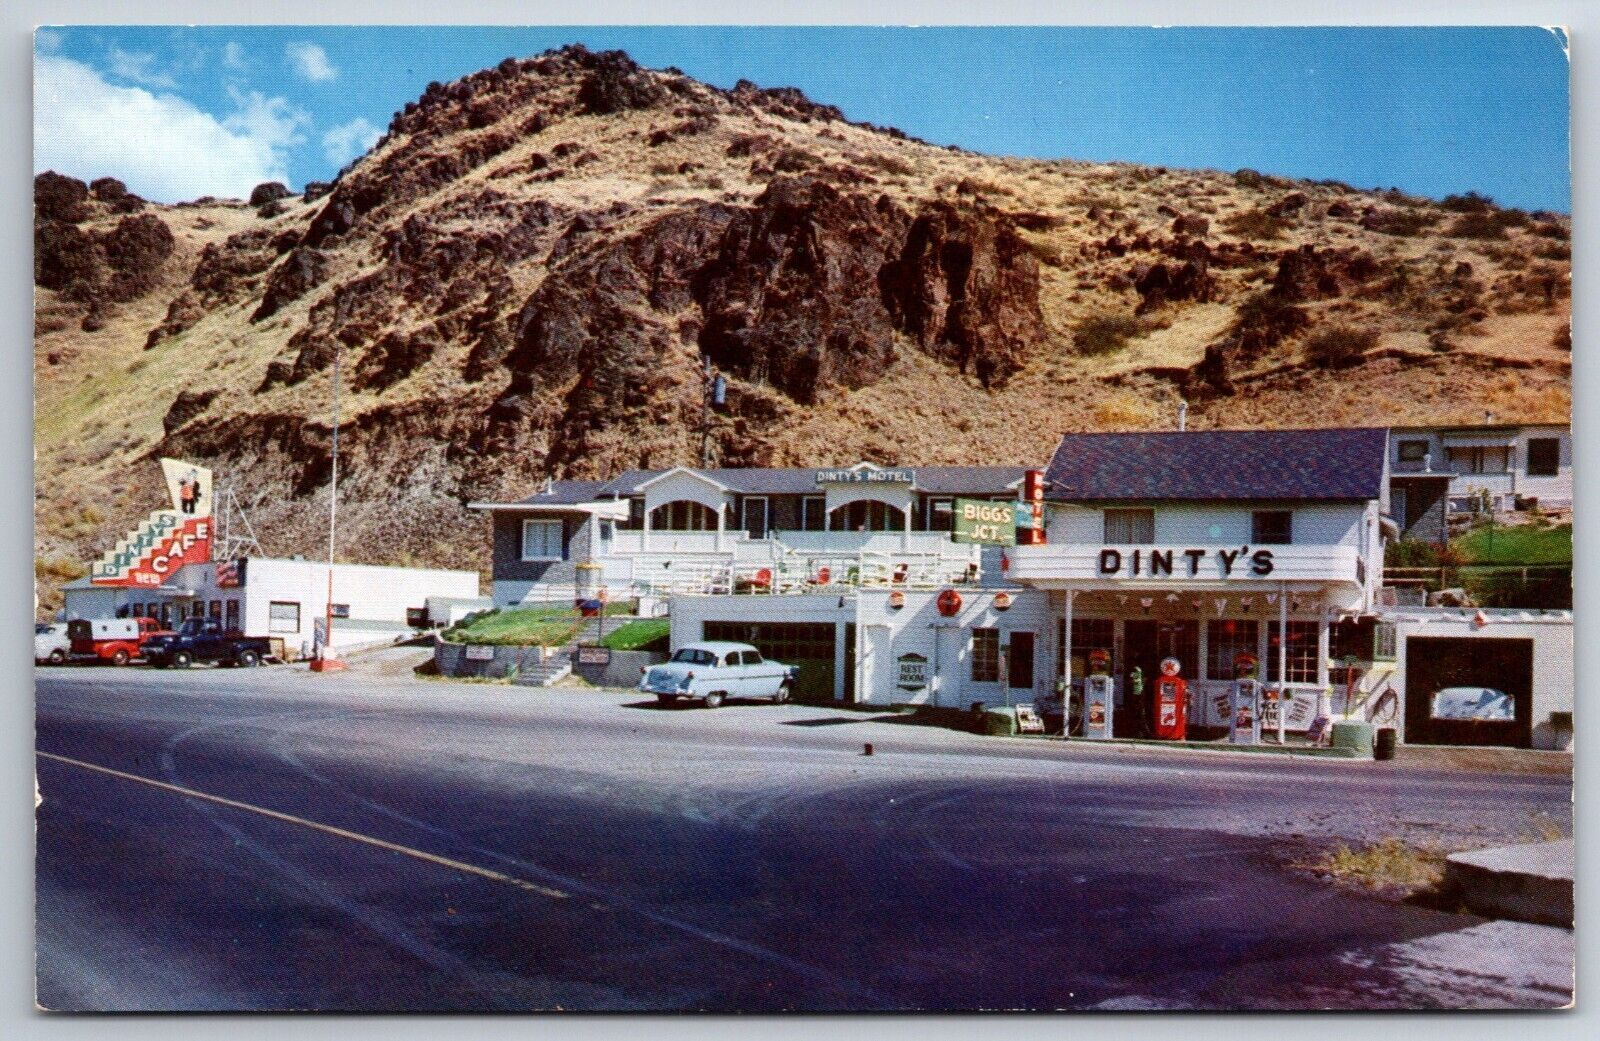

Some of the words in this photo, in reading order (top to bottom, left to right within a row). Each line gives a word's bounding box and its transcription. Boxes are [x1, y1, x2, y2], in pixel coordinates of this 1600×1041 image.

[867, 470, 911, 482] MOTEL
[964, 503, 1011, 524] BIGGS
[152, 523, 208, 573] CAFE
[1100, 545, 1274, 575] DINTY'S
[900, 664, 922, 674] REST
